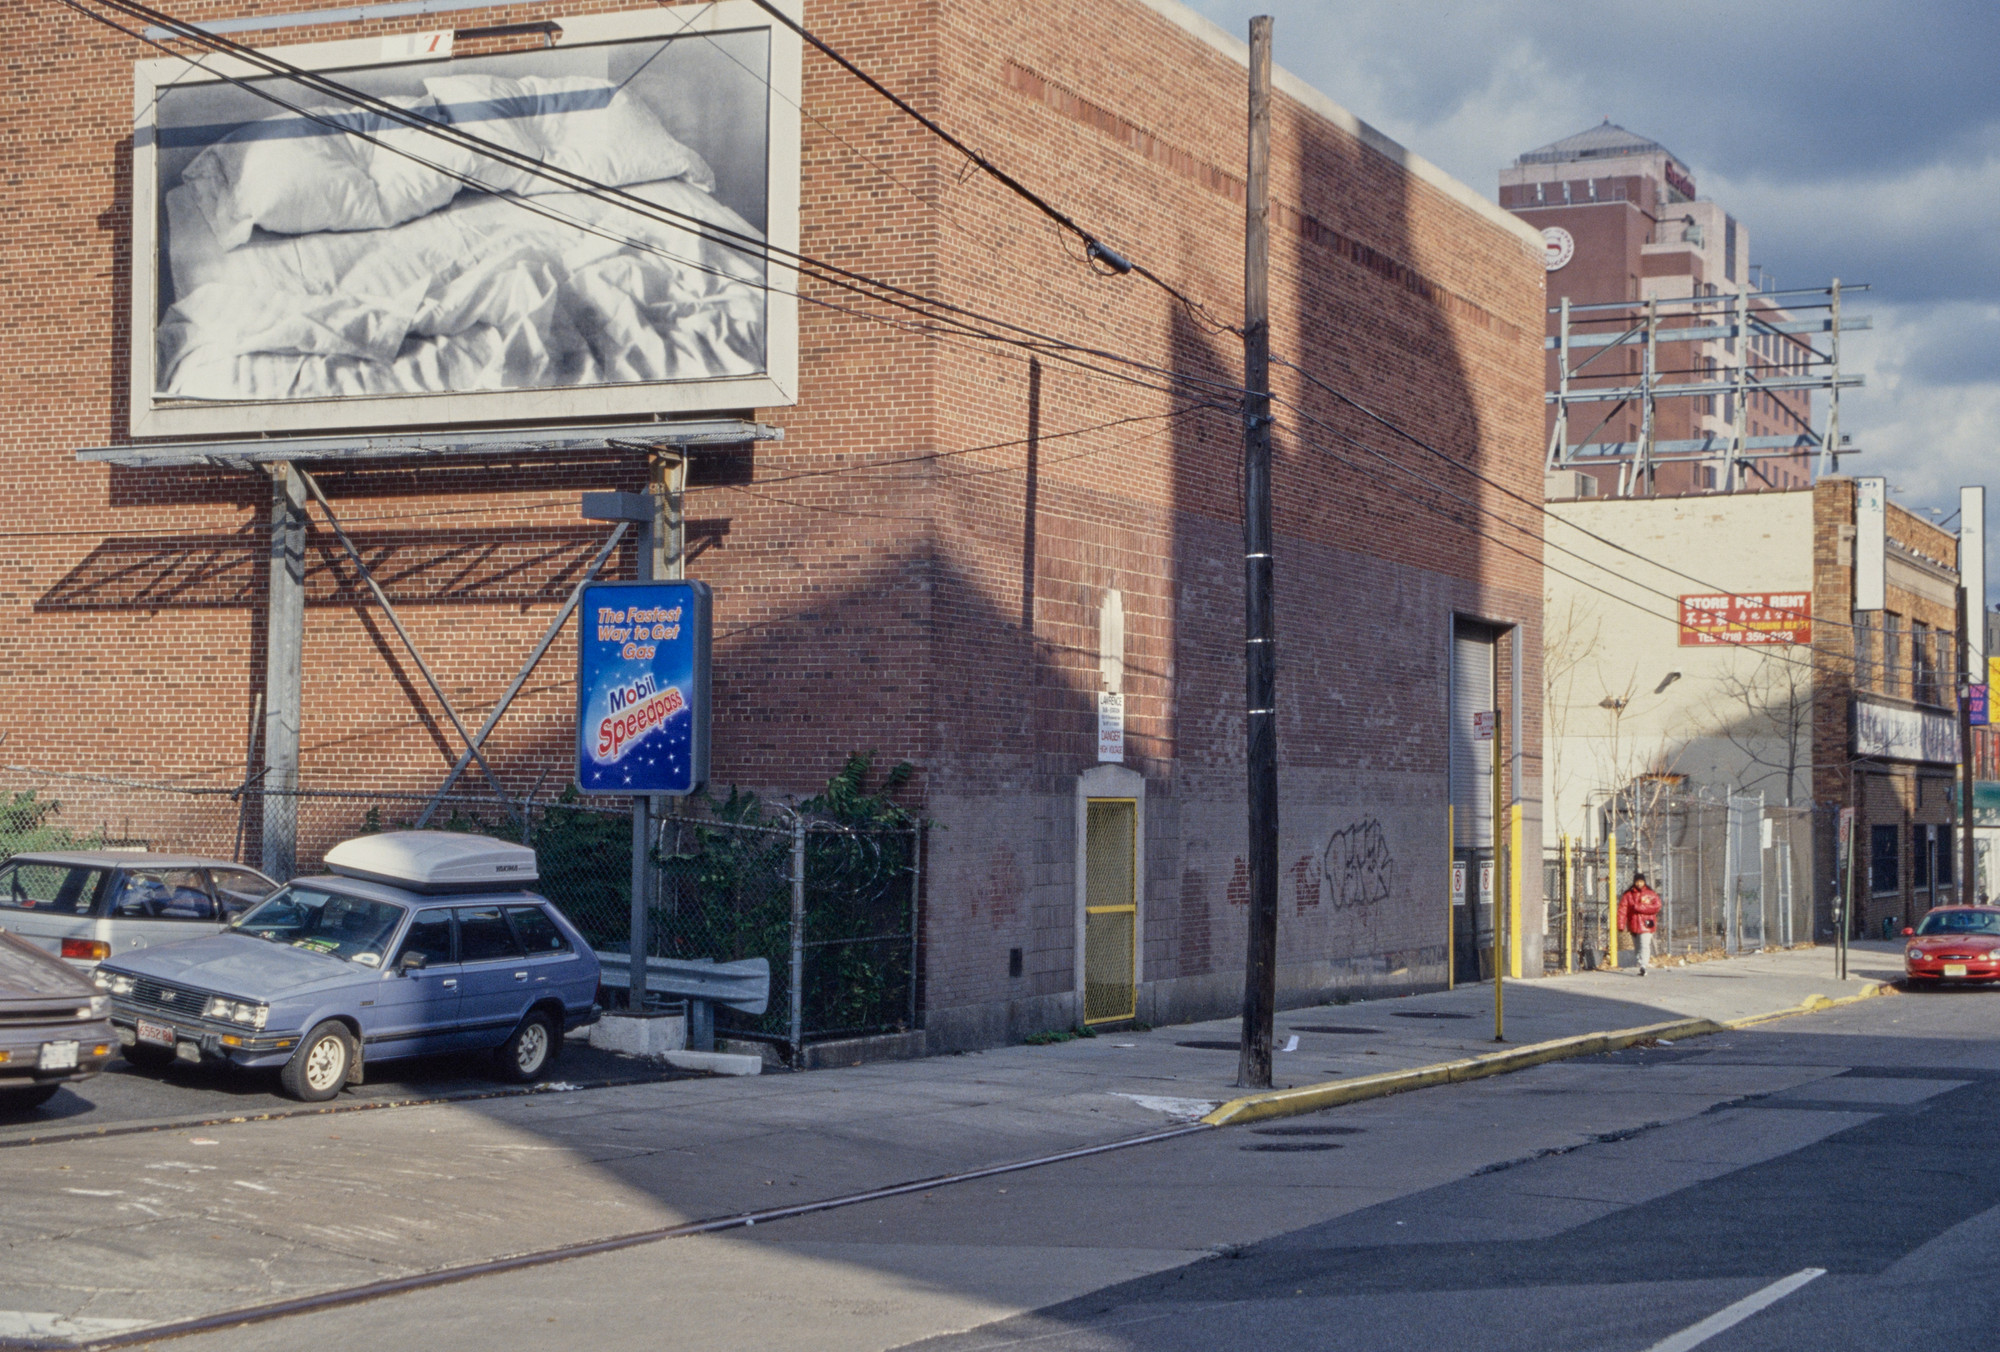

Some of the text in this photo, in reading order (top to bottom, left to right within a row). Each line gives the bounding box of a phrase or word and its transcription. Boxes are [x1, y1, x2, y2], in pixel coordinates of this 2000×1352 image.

[1685, 595, 1807, 610] STORE FOR RENT
[598, 606, 682, 624] The Fastest
[598, 624, 680, 643] Way to Get
[622, 643, 656, 660] Gas
[609, 675, 656, 713] Mobil
[598, 690, 683, 759] Speedpass
